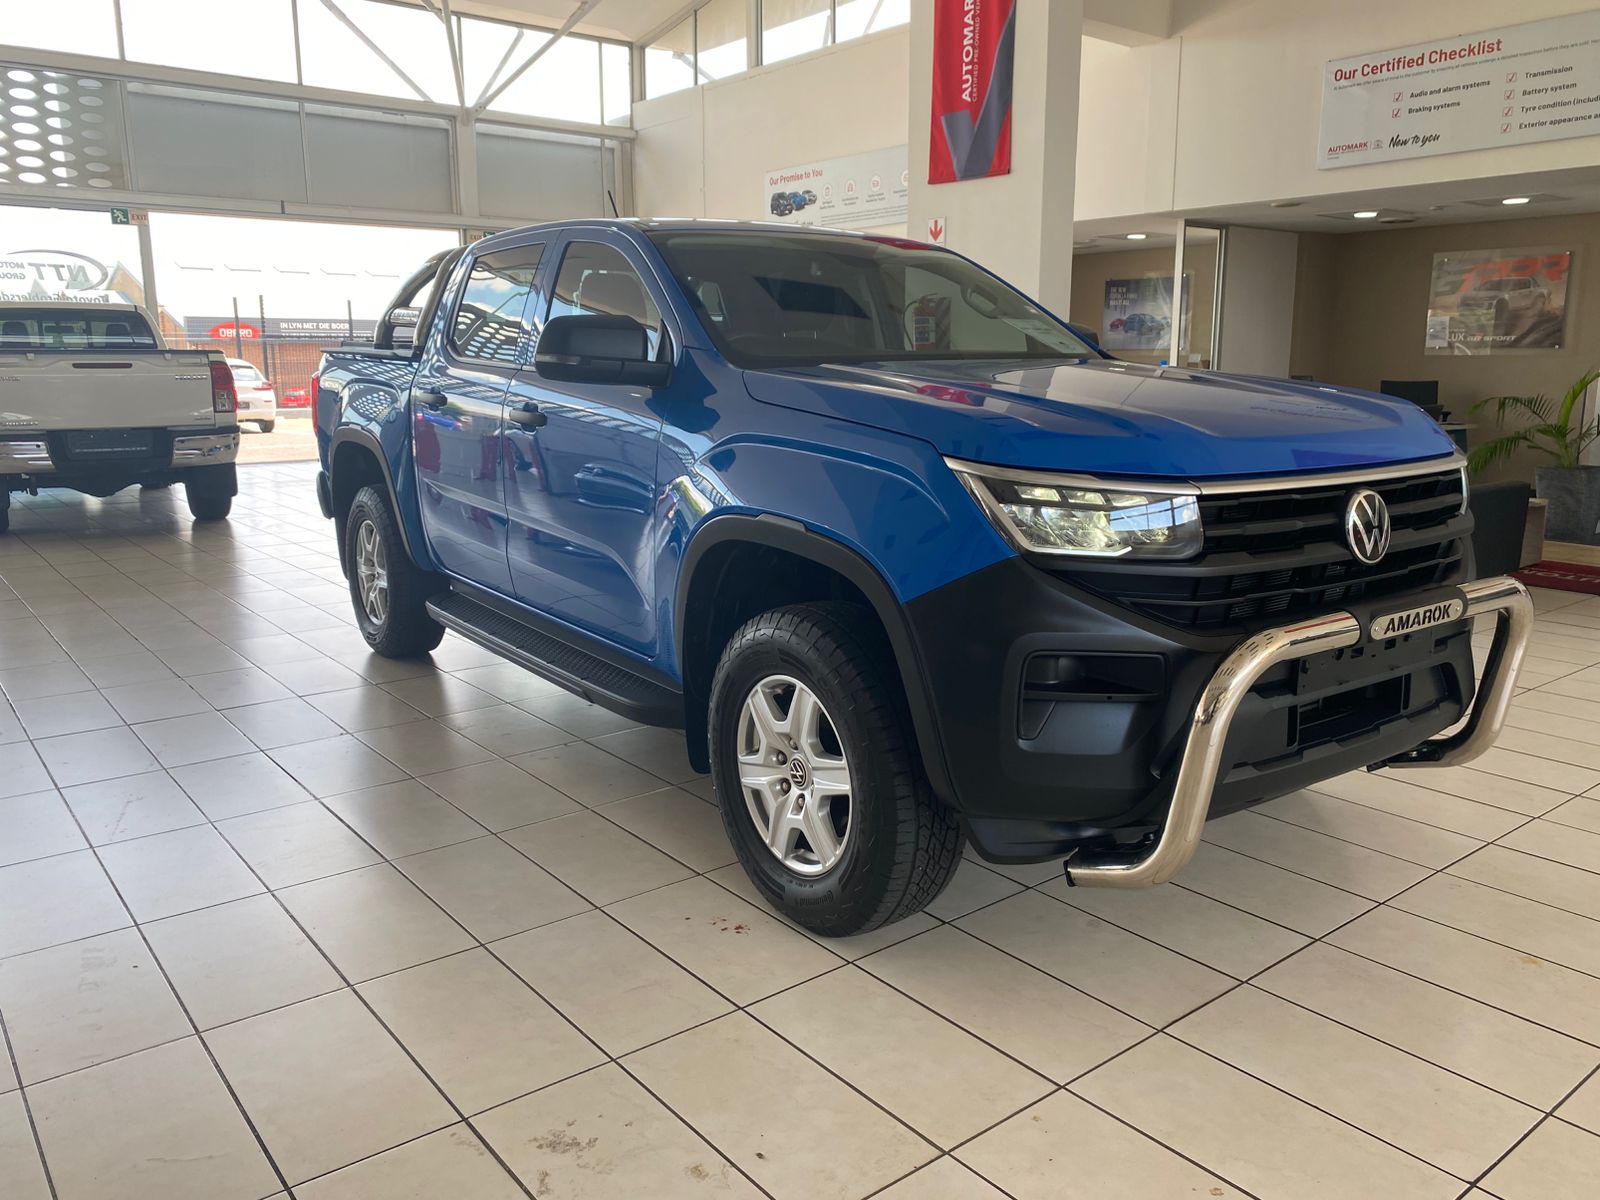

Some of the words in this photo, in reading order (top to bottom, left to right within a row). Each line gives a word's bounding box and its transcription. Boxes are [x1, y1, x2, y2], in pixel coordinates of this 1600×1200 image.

[1334, 68, 1358, 82] Our
[1361, 52, 1425, 77] Certified
[1429, 38, 1503, 65] Checklist
[1525, 66, 1573, 79] Transmission
[1409, 90, 1428, 99] Audio
[1429, 88, 1442, 97] and
[1442, 85, 1461, 95] alarm
[1461, 79, 1491, 92] systems
[1522, 87, 1549, 98] Battery
[1550, 82, 1577, 94] system
[1408, 104, 1433, 115] Braking
[1434, 100, 1461, 112] systems
[1520, 105, 1537, 114] Tyre
[1538, 99, 1572, 111] condition
[1518, 118, 1548, 130] Exterior
[1548, 114, 1592, 128] appearance
[1328, 141, 1368, 154] AUTOMARK
[1389, 133, 1410, 149] New
[1420, 133, 1441, 149] you
[768, 176, 780, 187] Our
[779, 172, 803, 184] Promise
[804, 169, 811, 180] to
[811, 168, 823, 178] You
[319, 322, 330, 330] DIE
[1383, 602, 1453, 635] AMAROK
